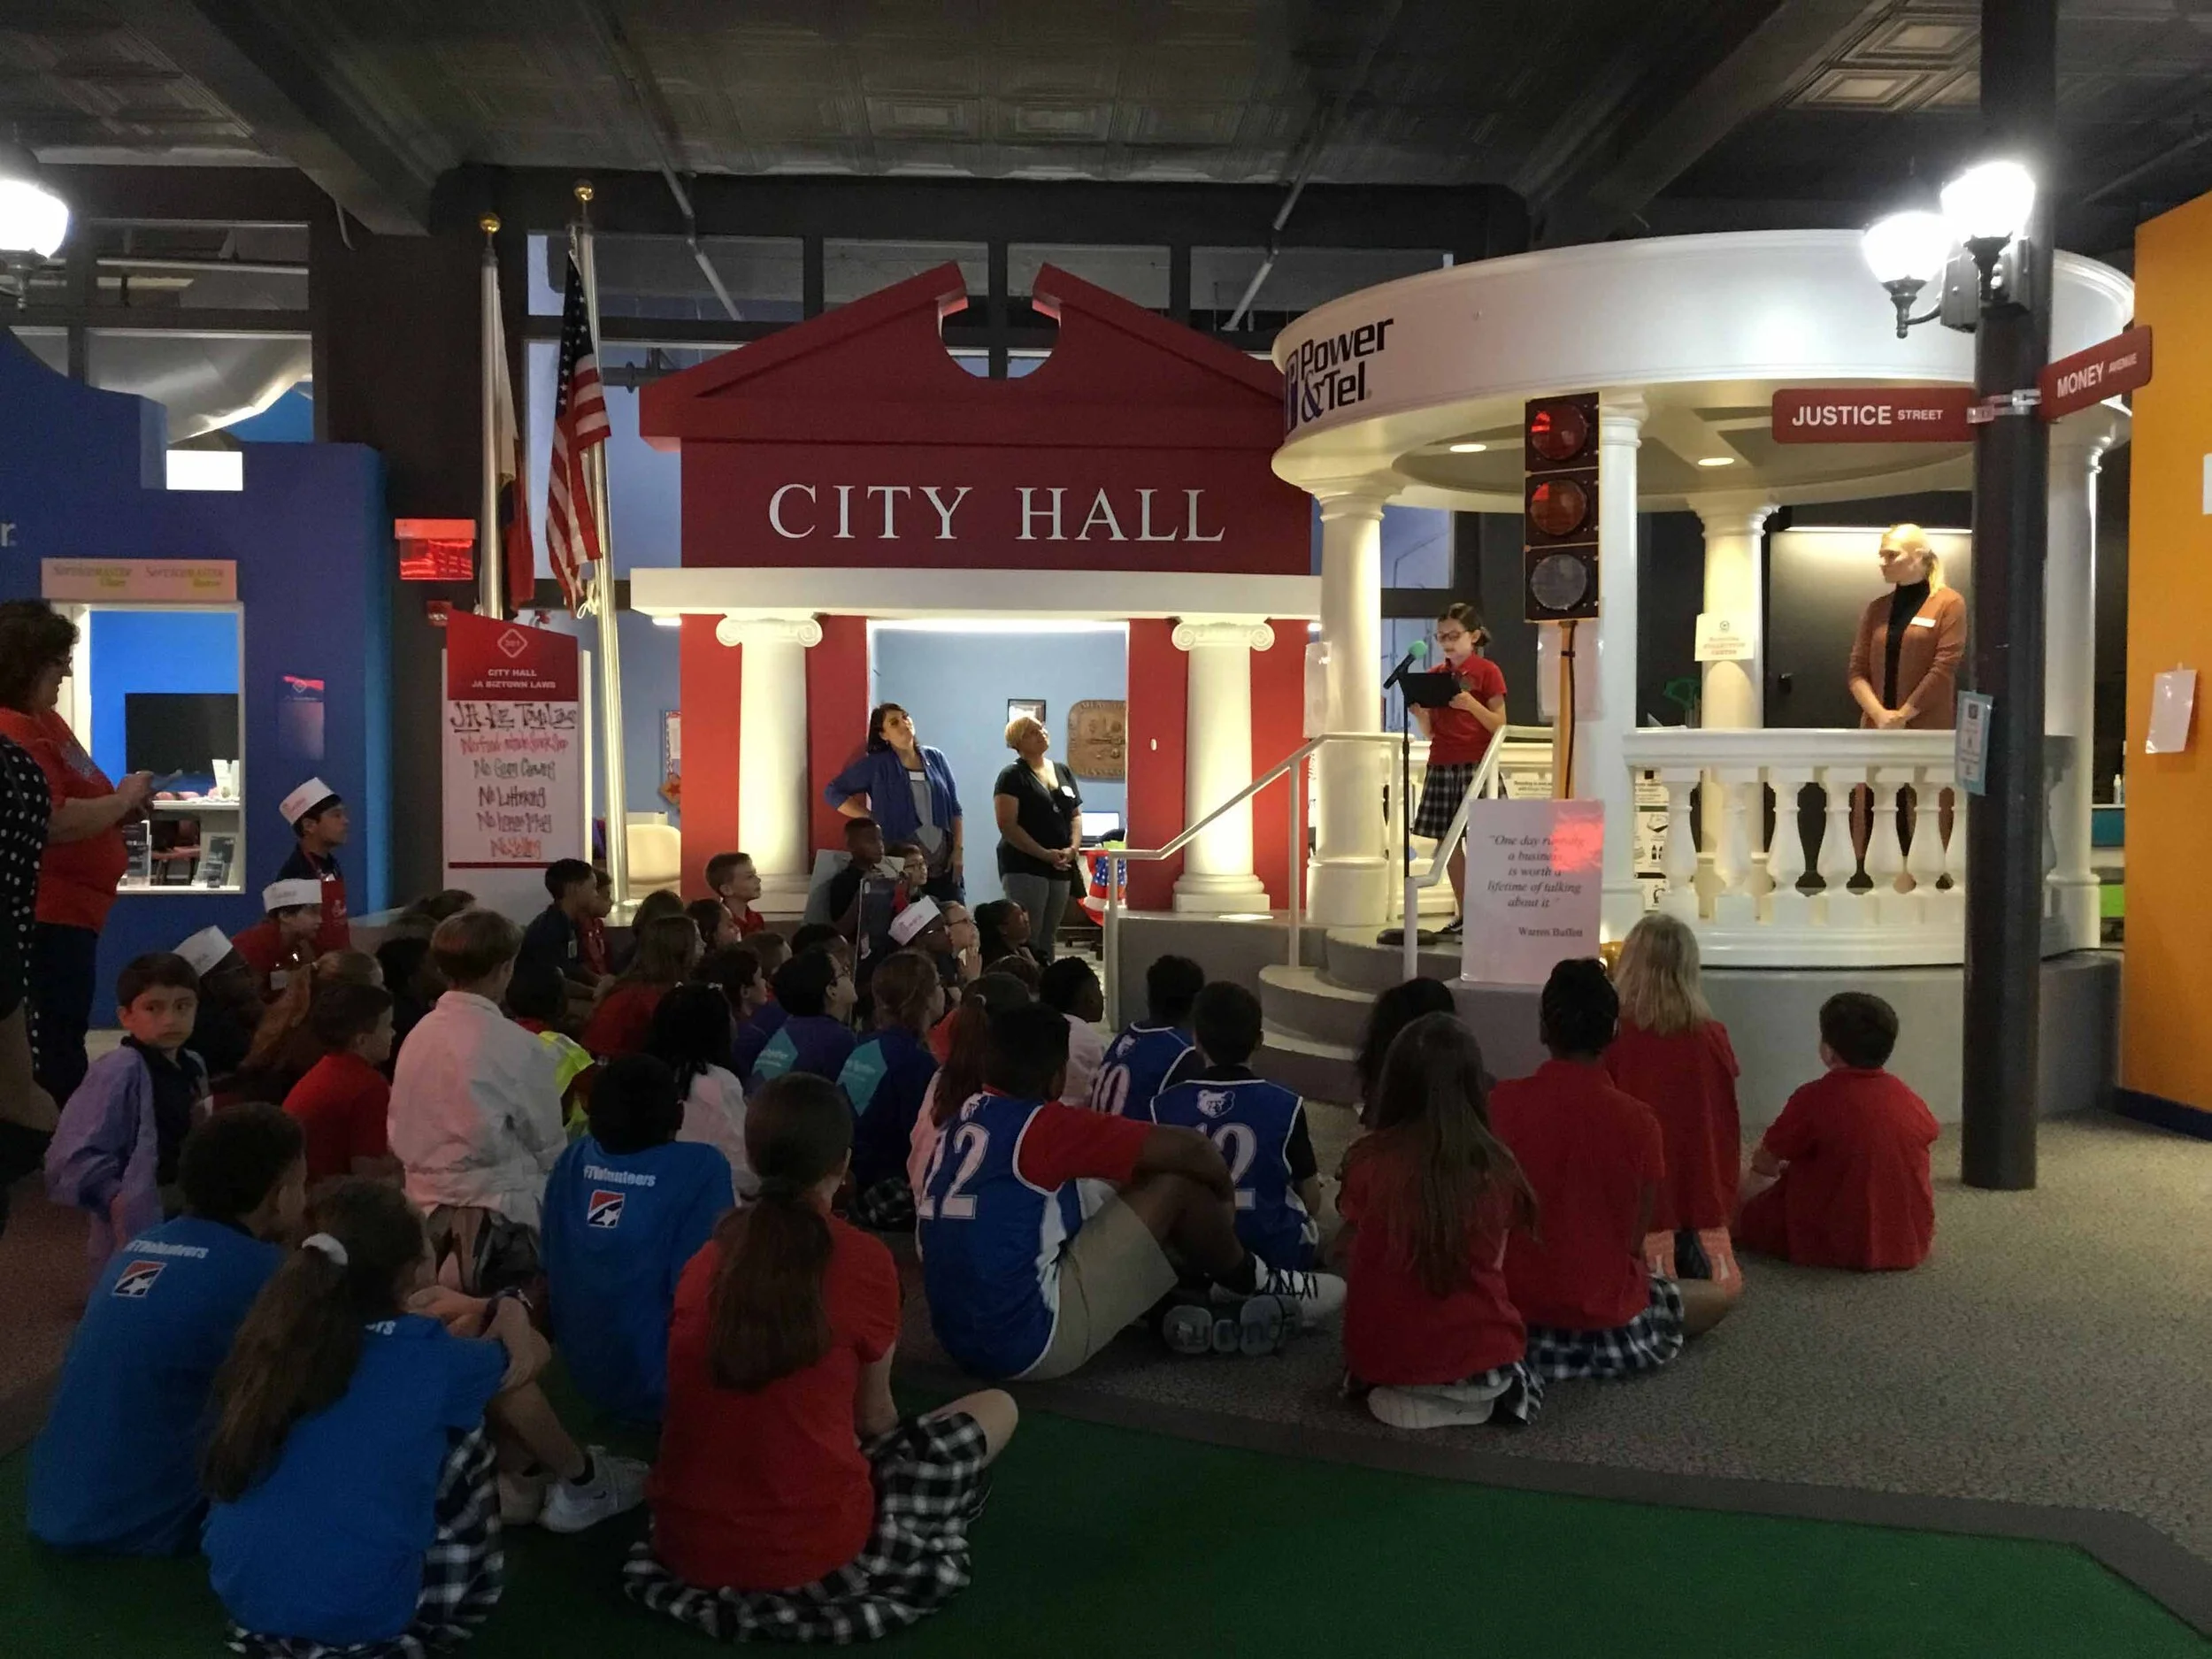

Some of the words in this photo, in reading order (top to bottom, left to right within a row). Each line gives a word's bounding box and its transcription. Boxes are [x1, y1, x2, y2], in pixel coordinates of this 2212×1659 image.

[1301, 318, 1394, 381] Power
[2056, 361, 2104, 399] MONEY
[2108, 352, 2138, 373] AVENUE
[1792, 405, 1893, 426] JUSTICE
[1897, 410, 1944, 420] STREET
[767, 482, 973, 541] CITY
[1015, 486, 1226, 542] HALL
[488, 668, 511, 678] CITY
[511, 668, 538, 678] HALL
[486, 680, 528, 689] BIZTOWN
[530, 680, 557, 689] LAWS
[479, 784, 495, 807] No
[1520, 834, 1540, 849] day
[1508, 866, 1517, 877] is
[1521, 866, 1552, 877] worth
[1487, 881, 1528, 893] lifetime
[1530, 881, 1544, 895] of
[1544, 882, 1582, 895] talking
[1508, 896, 1539, 908] about
[1518, 926, 1550, 937] Warren
